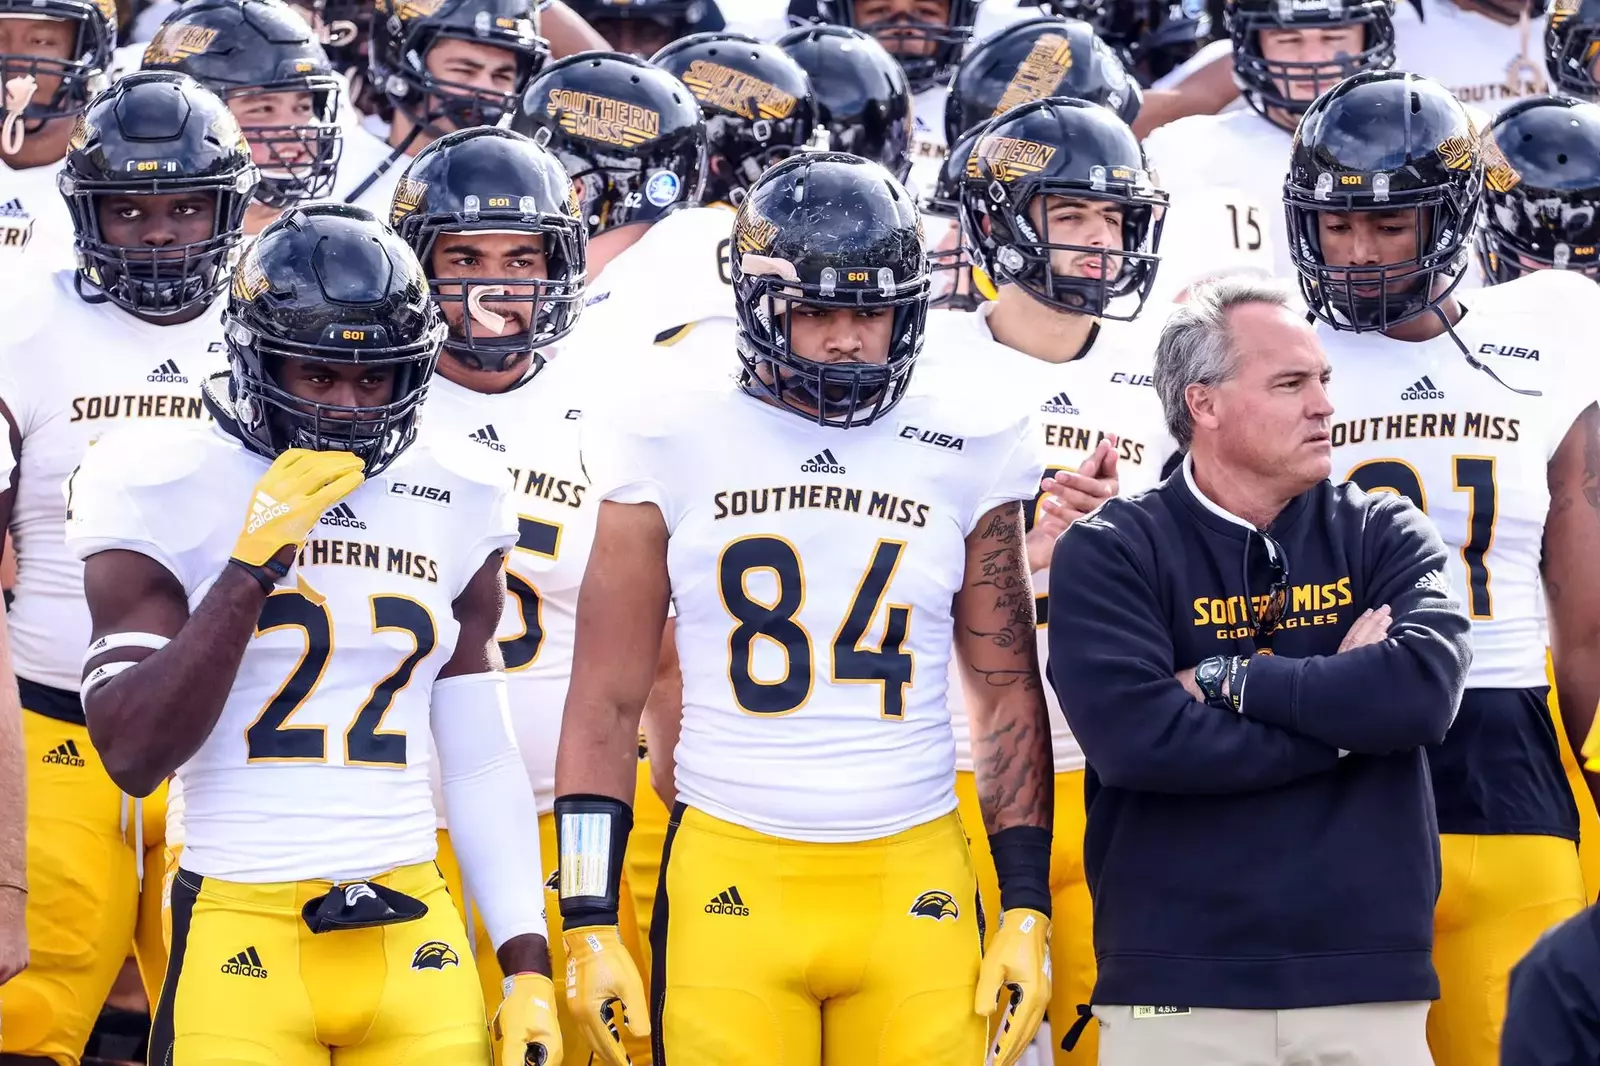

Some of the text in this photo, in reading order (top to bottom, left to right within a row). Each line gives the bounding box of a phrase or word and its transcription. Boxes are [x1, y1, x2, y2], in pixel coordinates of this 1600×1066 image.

[547, 89, 659, 134] SOUTHERN
[576, 114, 623, 145] MISS
[1341, 175, 1362, 185] 601
[489, 198, 510, 207] 601
[624, 191, 642, 208] 62
[848, 272, 869, 281] 601
[342, 330, 365, 341] 601
[147, 373, 188, 383] adidas
[1401, 389, 1444, 400] adidas
[70, 395, 202, 422] SOUTHERN
[1041, 405, 1080, 415] adidas
[1464, 412, 1520, 442] MISS
[801, 462, 846, 474] adidas
[524, 470, 586, 508] MISS
[714, 485, 930, 528] SOUTHERN MISS
[247, 502, 290, 534] adidas
[320, 513, 367, 530] adidas
[387, 547, 438, 583] MISS
[1292, 576, 1353, 612] MISS
[717, 533, 915, 720] 84
[245, 587, 438, 769] 22
[42, 752, 85, 767] adidas
[704, 901, 749, 917] adidas
[221, 962, 268, 979] adidas
